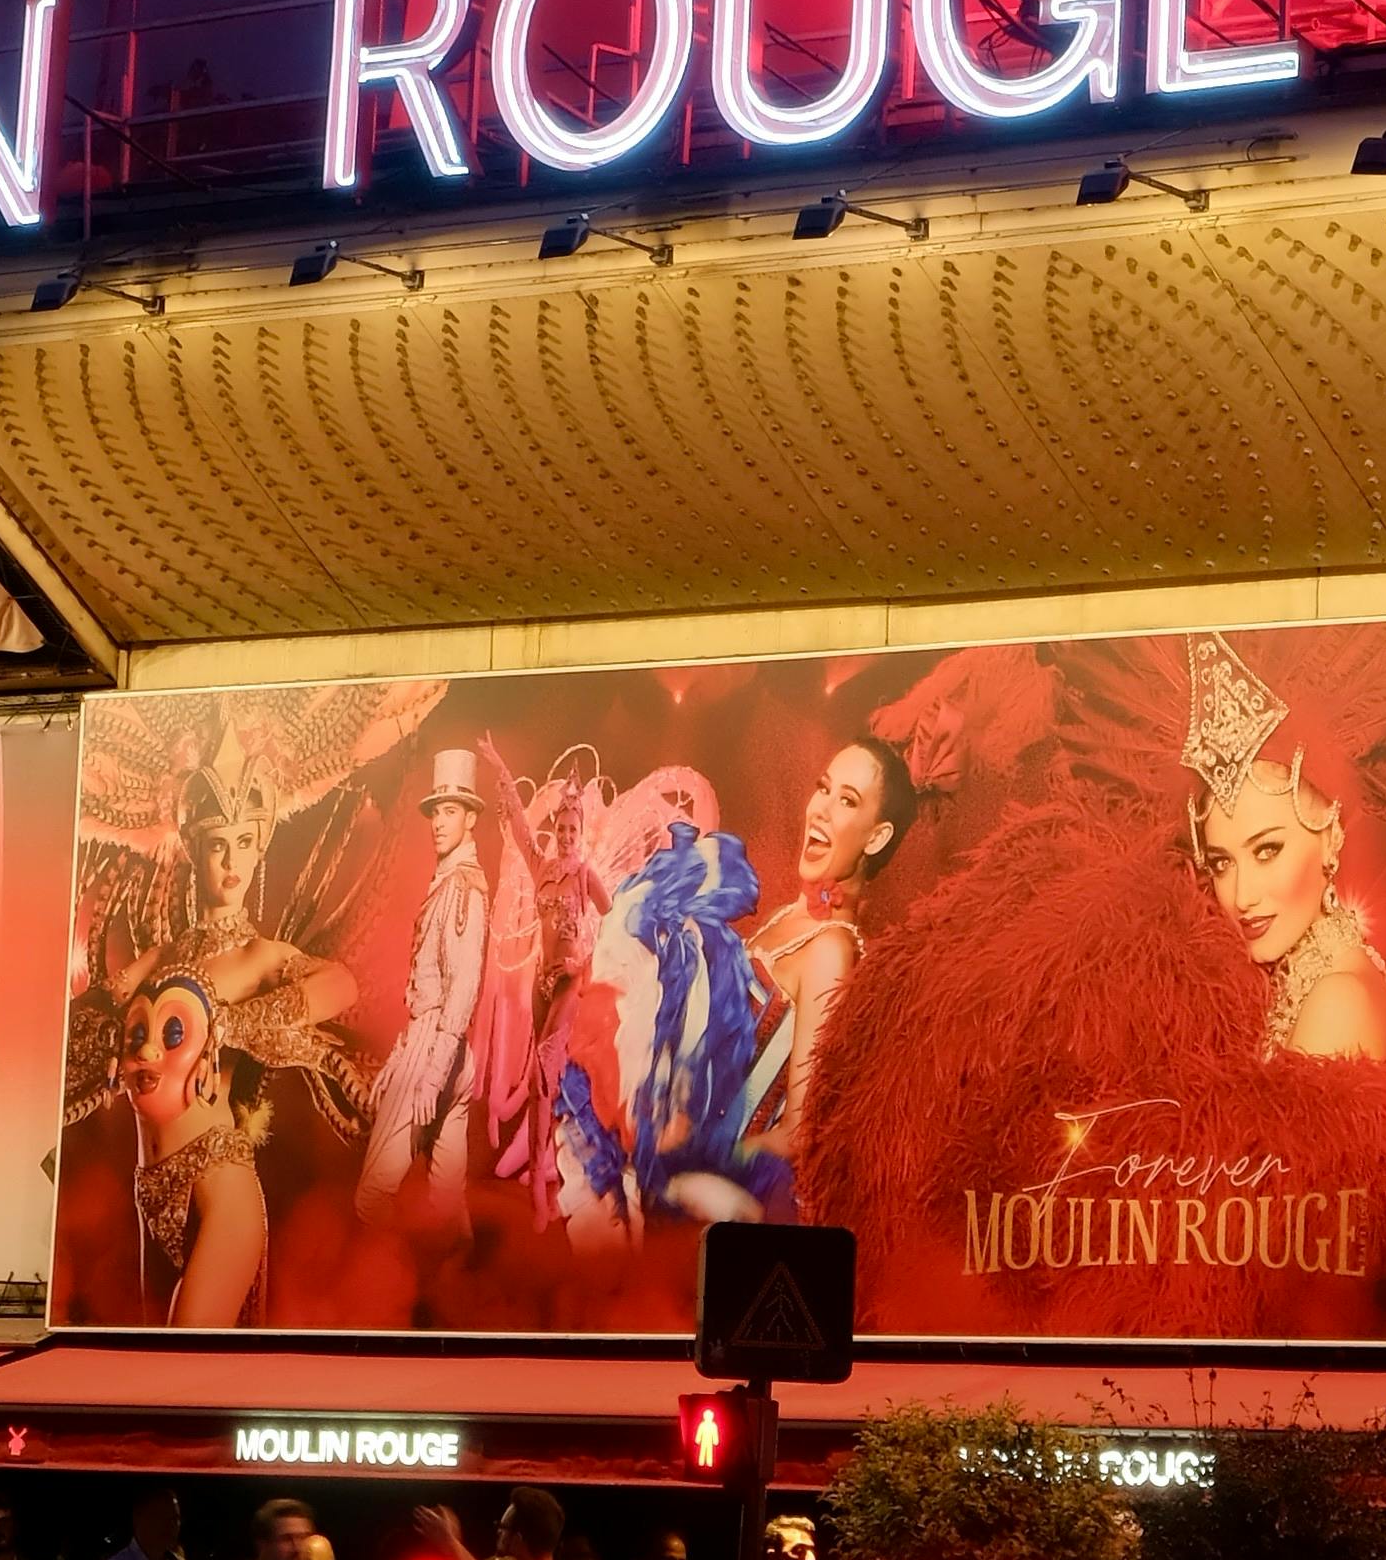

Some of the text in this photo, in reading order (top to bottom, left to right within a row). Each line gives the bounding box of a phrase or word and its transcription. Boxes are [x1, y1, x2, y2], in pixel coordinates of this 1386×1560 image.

[1023, 1099, 1291, 1224] Forever
[961, 1190, 1163, 1276] MOULIN
[1173, 1188, 1368, 1277] ROUGE
[235, 1429, 460, 1467] MOULIN ROUGE
